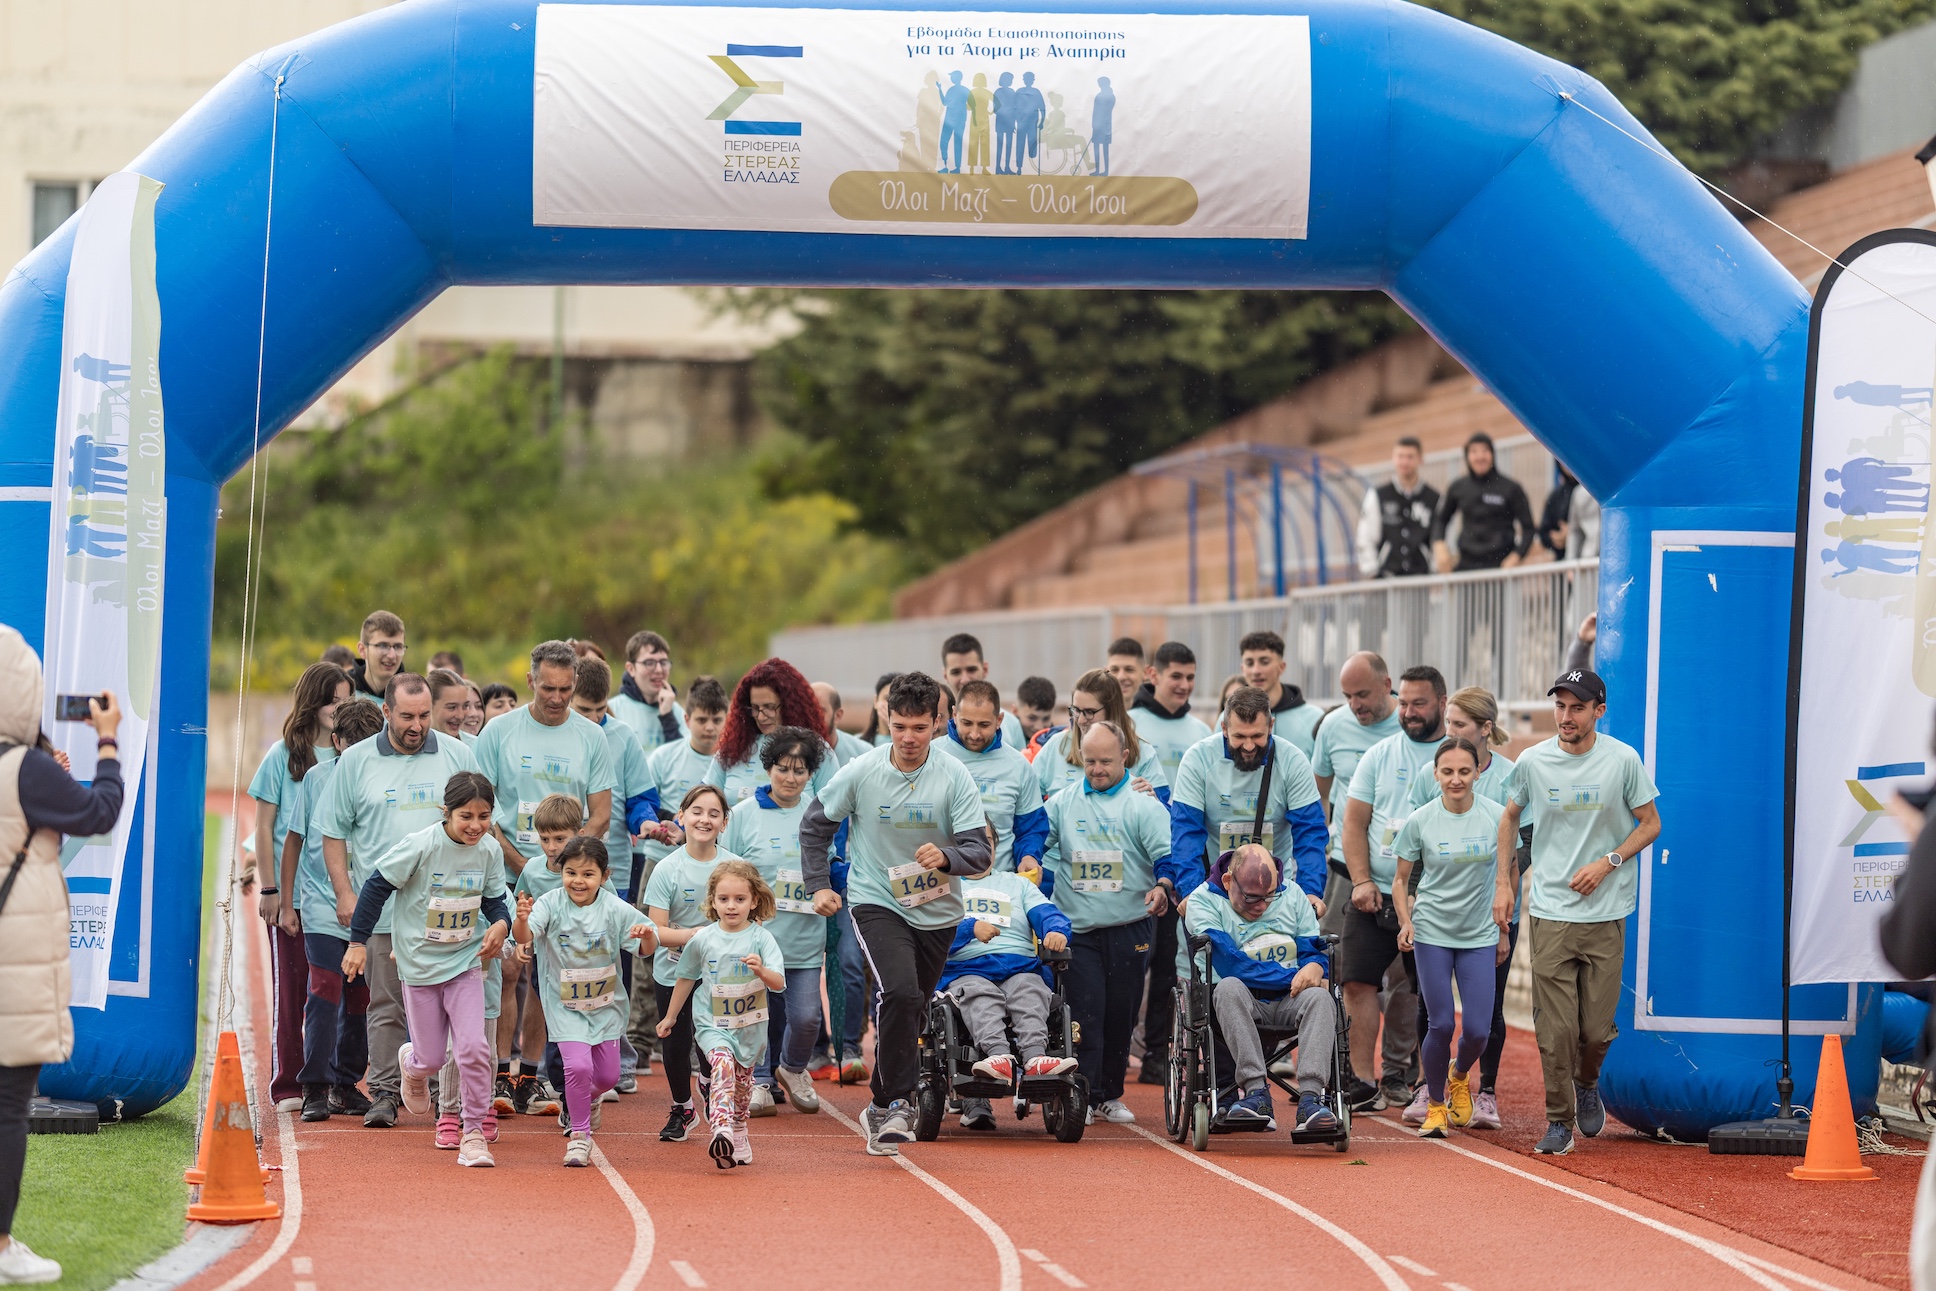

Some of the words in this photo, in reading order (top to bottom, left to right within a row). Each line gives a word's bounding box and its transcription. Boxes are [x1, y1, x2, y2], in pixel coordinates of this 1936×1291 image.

[907, 26, 982, 40] Εβδομάδα
[988, 27, 1125, 40] Ευαισθητοποίησης
[906, 44, 930, 58] για
[937, 45, 954, 56] τα
[961, 43, 1012, 60] Άτομα
[1020, 47, 1040, 60] με
[1046, 44, 1126, 61] Αναπηρία
[724, 140, 801, 153] ΠΕΡΙΦΕΡΕΙΑ
[724, 155, 800, 169] ΣΤΕΡΕΑΣ
[724, 170, 800, 184] ΕΛΛΑΔΑΣ
[878, 180, 929, 211] Όλοι
[941, 181, 991, 222] Μαζί
[1027, 183, 1077, 214] Όλοι
[1084, 184, 1127, 215] Ίσοι
[138, 408, 161, 459] Όλοι
[136, 498, 164, 550] Μαζί
[136, 563, 160, 613] Όλοι
[1080, 863, 1113, 879] 152
[901, 871, 938, 895] 146
[966, 899, 1000, 914] 153
[436, 911, 471, 929] 115
[1255, 945, 1287, 962] 149
[571, 980, 607, 999] 117
[722, 994, 756, 1015] 102
